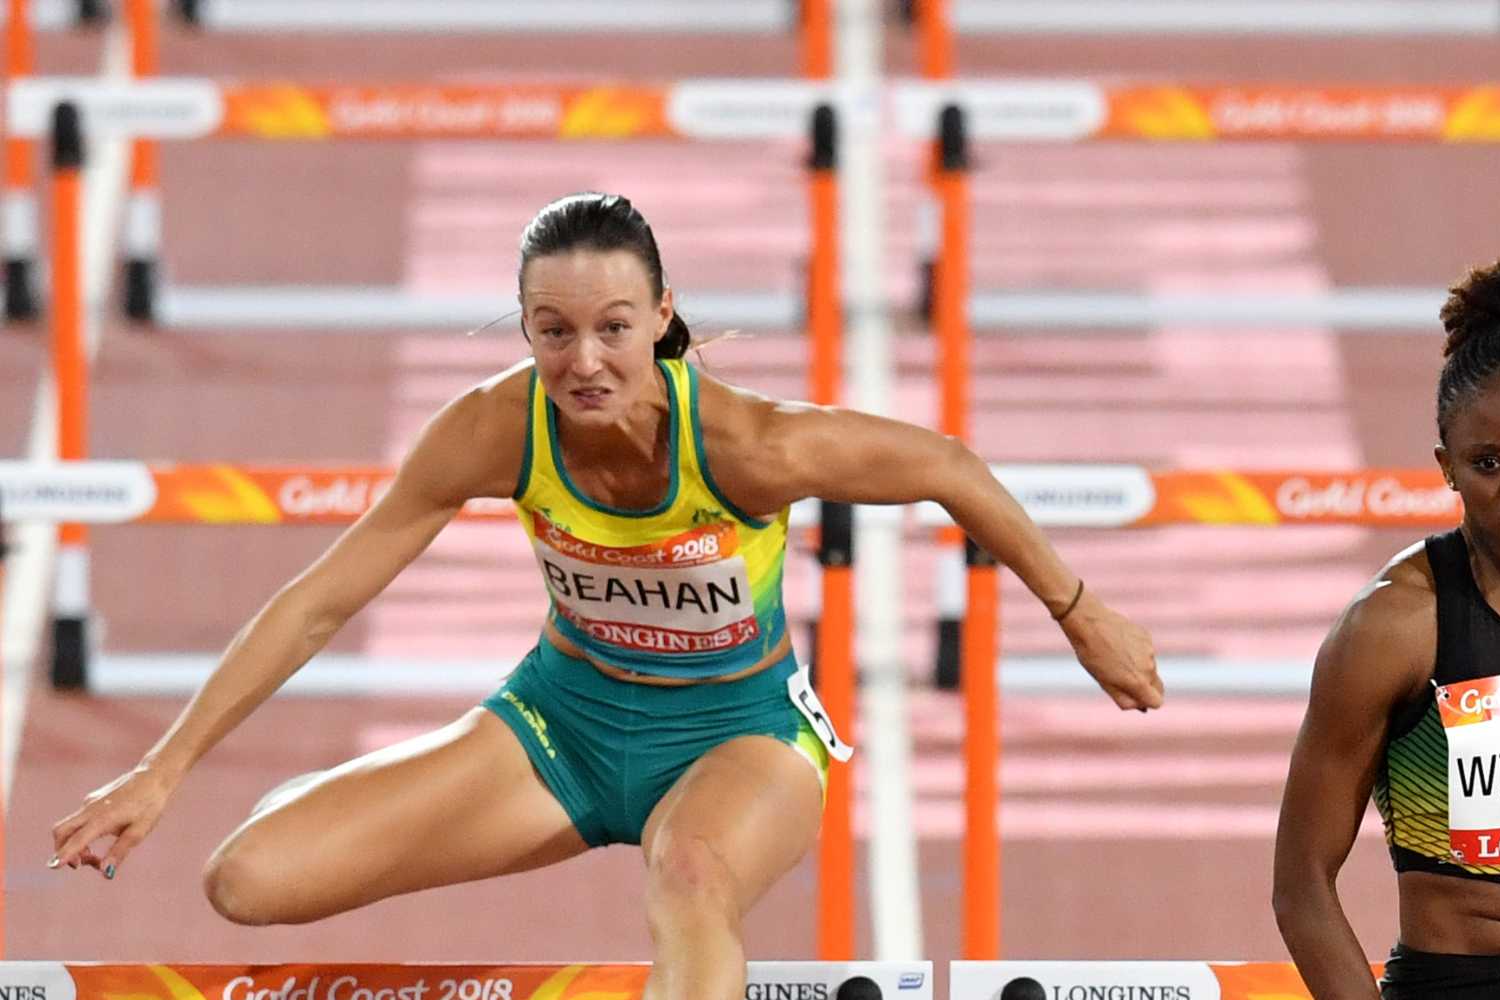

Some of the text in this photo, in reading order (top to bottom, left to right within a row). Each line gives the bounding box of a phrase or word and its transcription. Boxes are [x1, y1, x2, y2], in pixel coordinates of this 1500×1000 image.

[602, 548, 667, 566] Coast
[671, 532, 719, 562] 2018
[543, 559, 741, 615] BEAHAN
